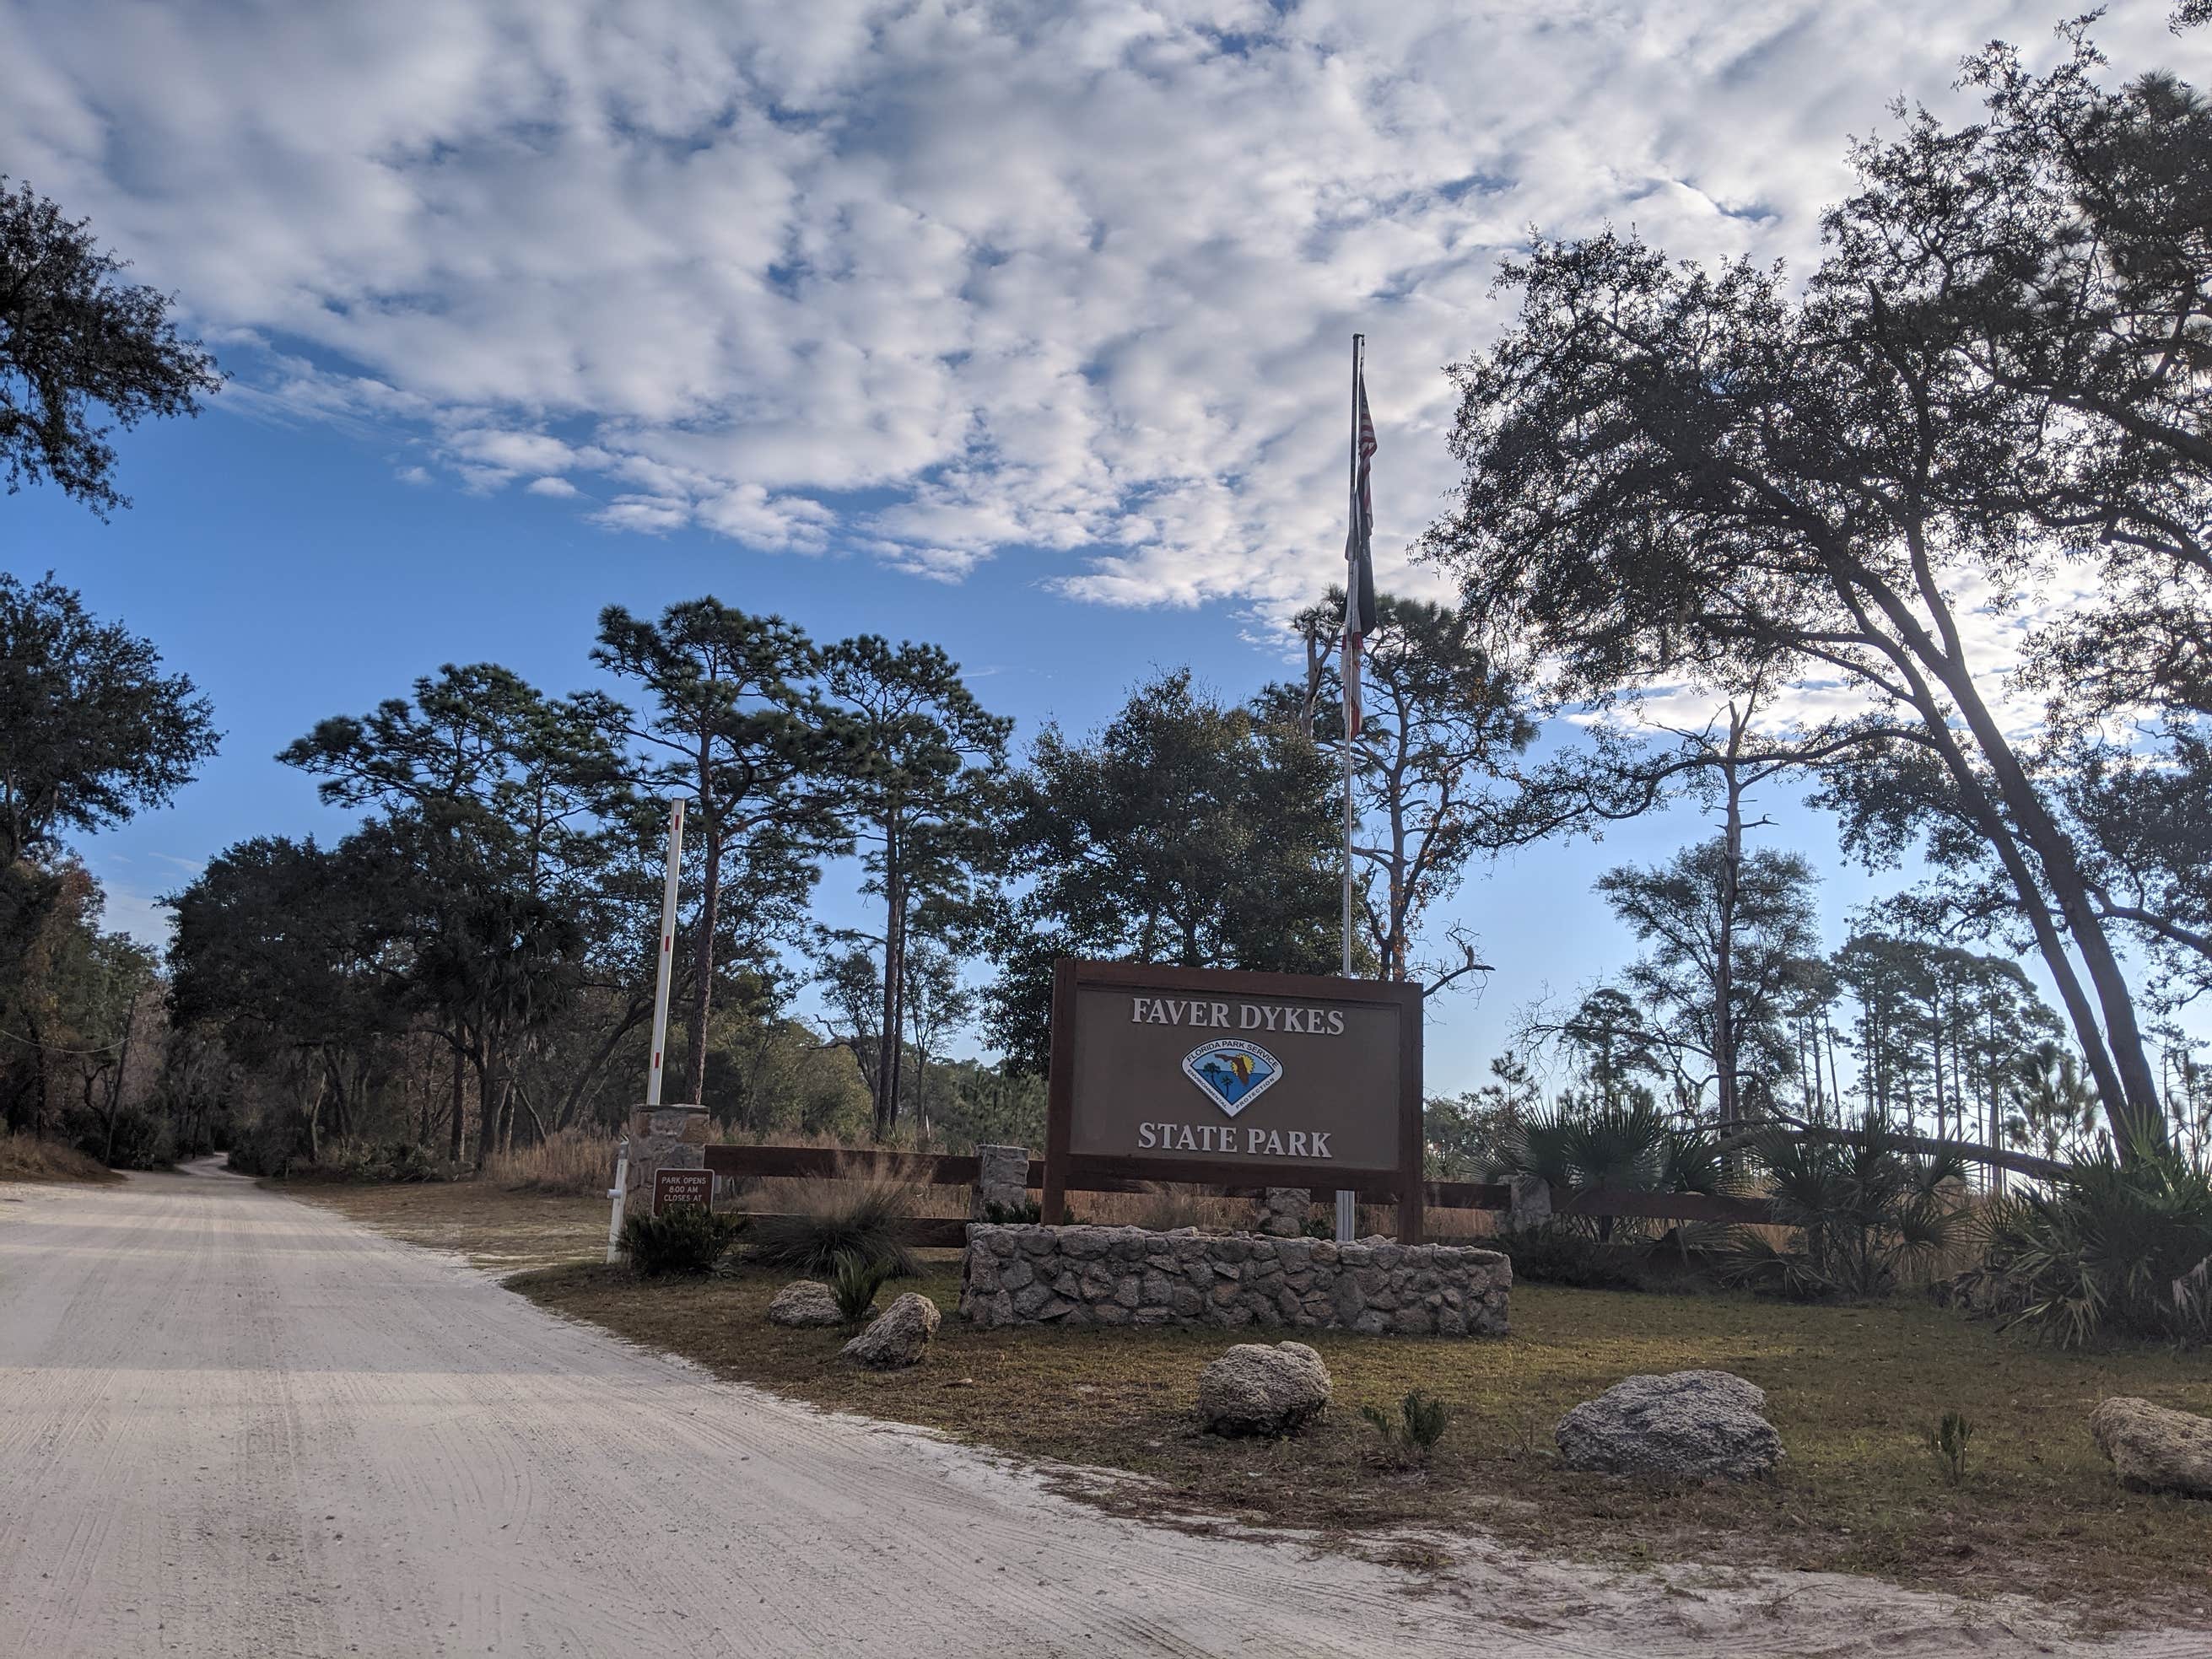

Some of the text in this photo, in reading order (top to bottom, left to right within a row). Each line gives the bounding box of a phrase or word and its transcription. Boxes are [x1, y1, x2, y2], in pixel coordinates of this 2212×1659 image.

[1131, 998, 1345, 1036] FAVER DYKES
[1186, 1040, 1278, 1069] FLORIDA PARK SERVICE
[1187, 1069, 1228, 1109] ENVIRONMENTAL
[1236, 1077, 1275, 1109] PROTECTION
[1138, 1122, 1332, 1158] STATE PARK
